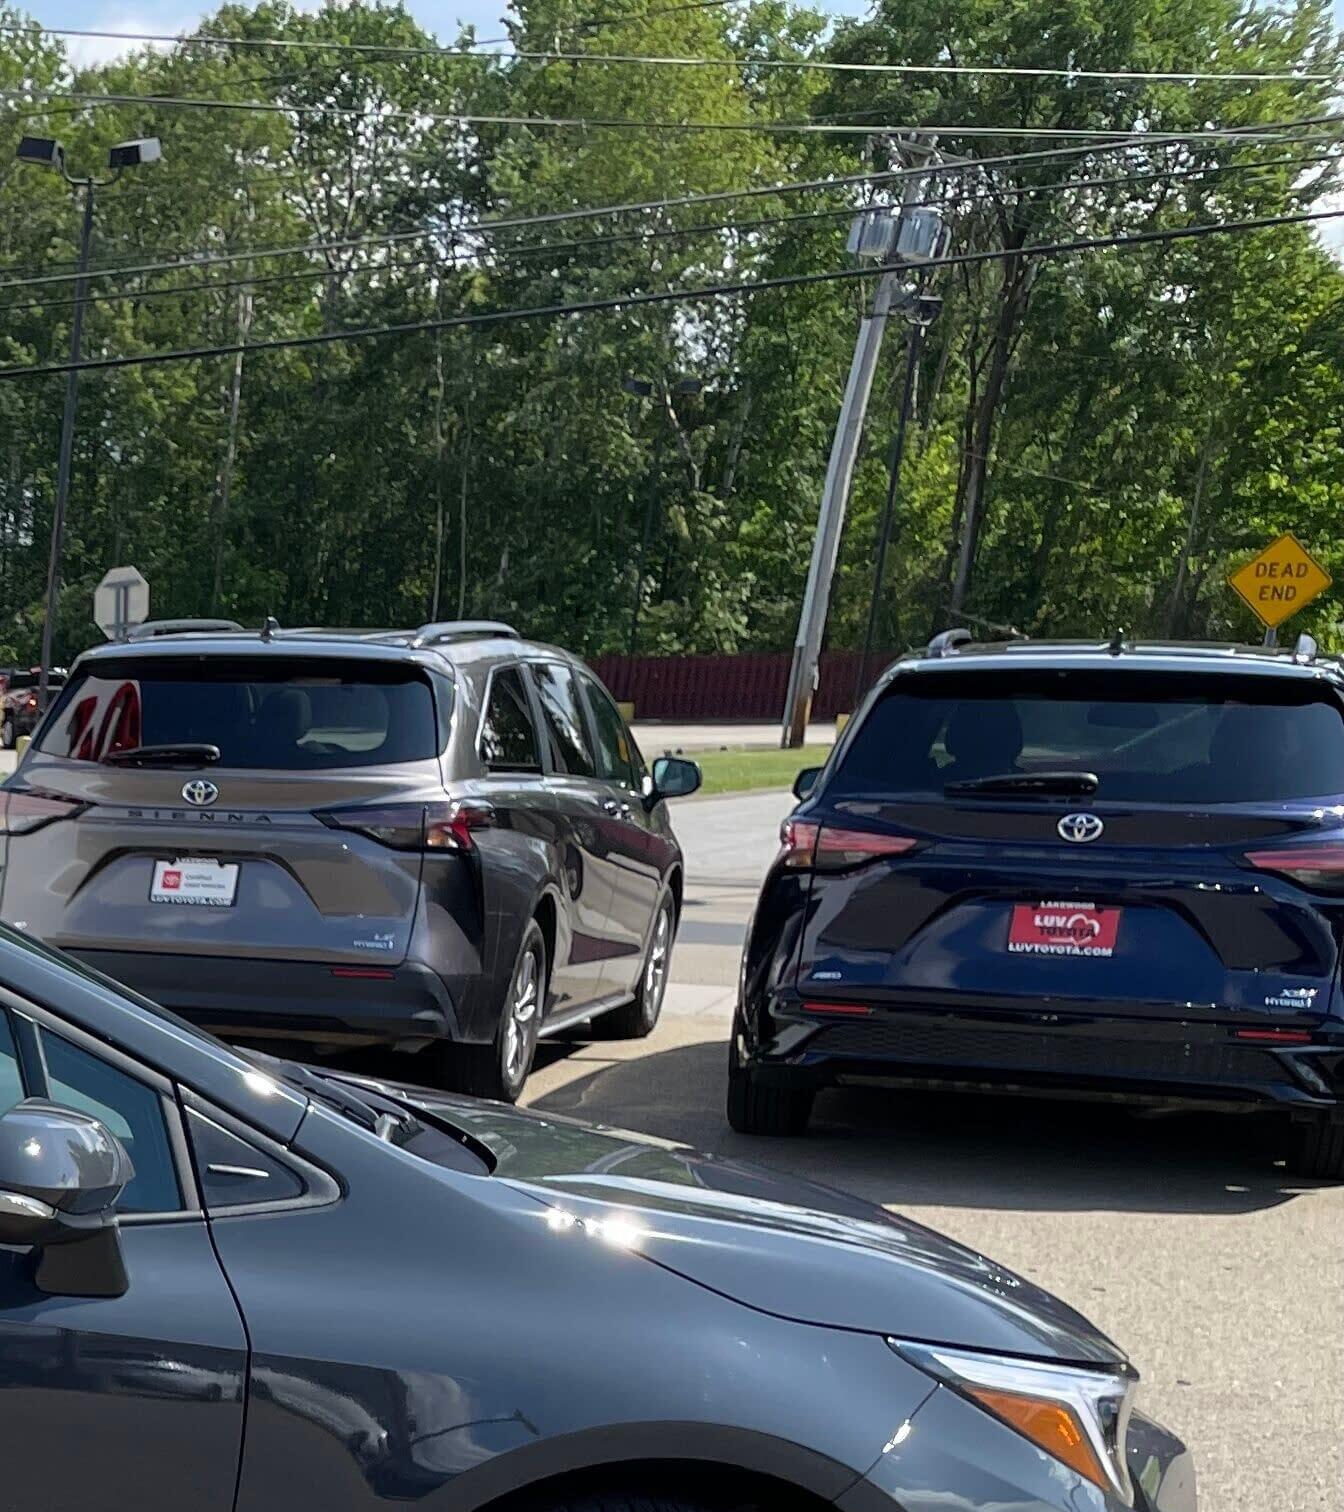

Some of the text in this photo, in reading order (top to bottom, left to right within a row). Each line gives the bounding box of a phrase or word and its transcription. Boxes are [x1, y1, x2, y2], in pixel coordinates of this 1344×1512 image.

[1255, 561, 1309, 579] DEAD
[1258, 584, 1297, 602] END
[128, 809, 272, 824] SIENNA
[1034, 914, 1067, 928] LUV
[1008, 942, 1113, 958] LUVTOYOTA.COM
